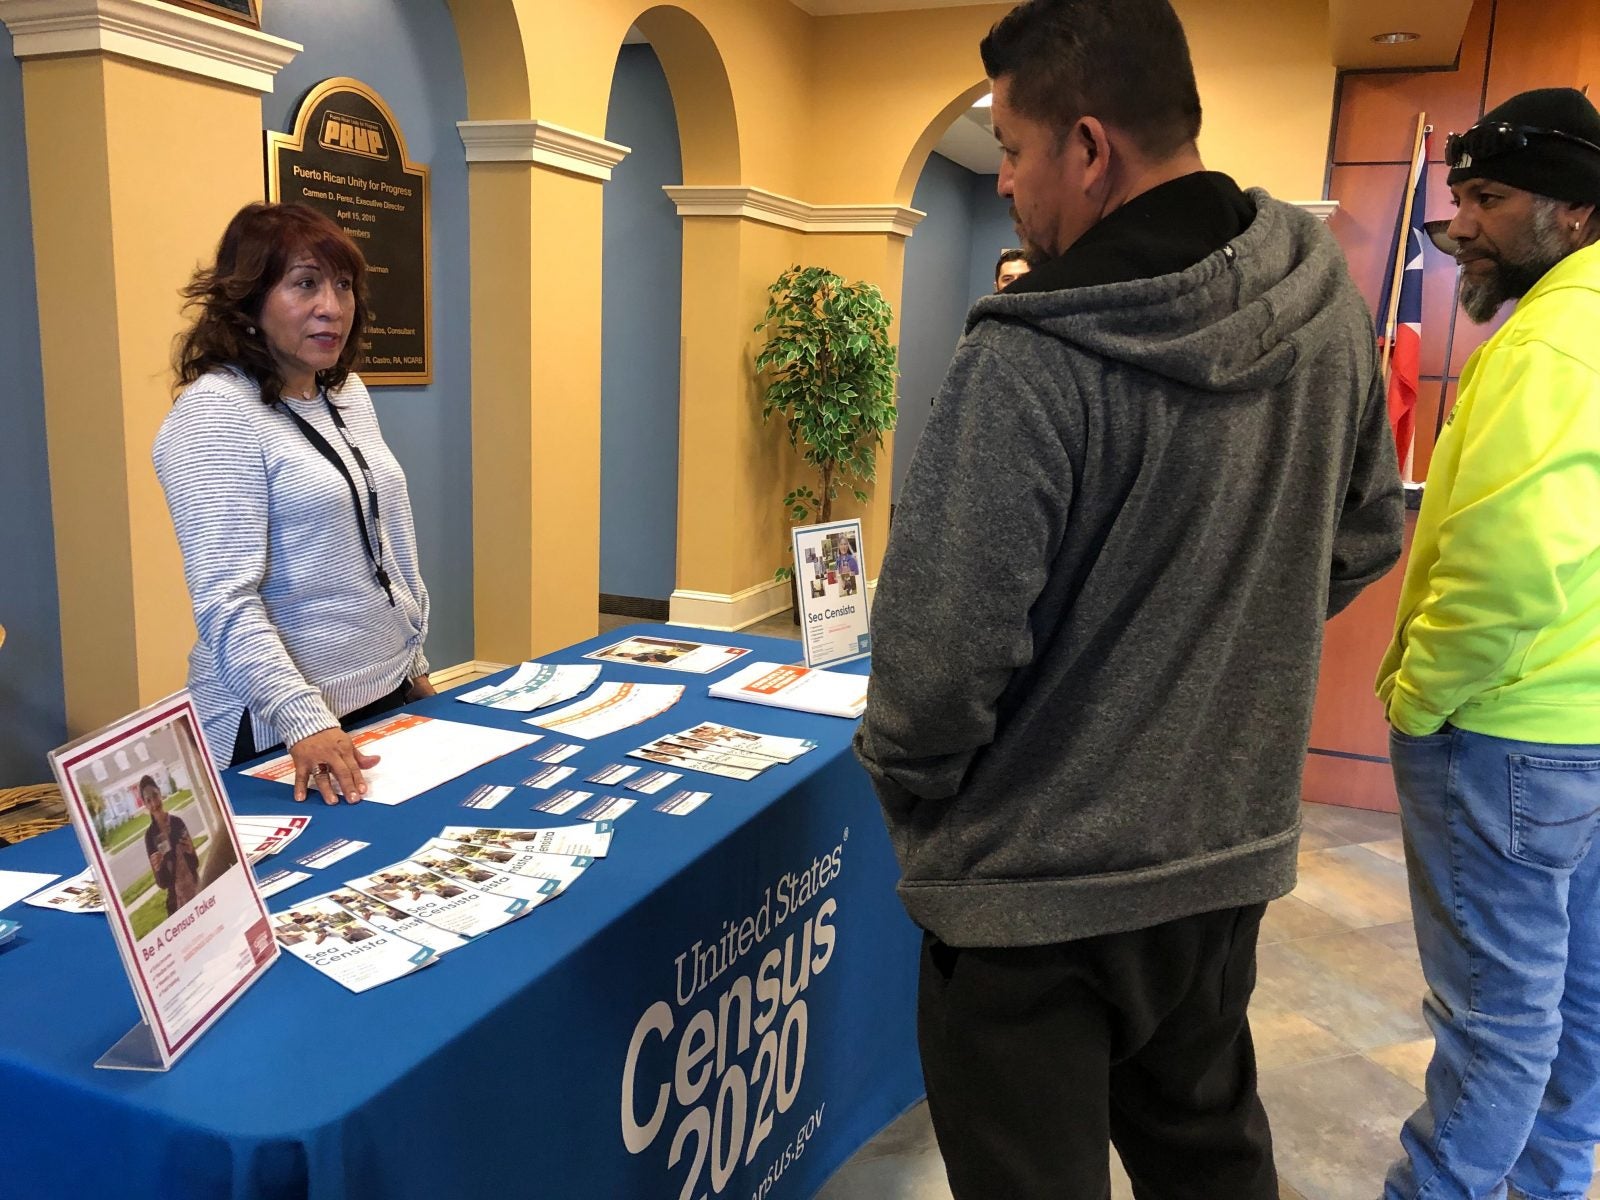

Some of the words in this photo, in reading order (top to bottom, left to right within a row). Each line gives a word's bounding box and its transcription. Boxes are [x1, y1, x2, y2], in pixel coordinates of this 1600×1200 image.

[324, 120, 384, 154] PRUP
[293, 165, 321, 180] Puerto
[323, 171, 346, 185] Rican
[347, 175, 368, 191] Unity
[369, 180, 380, 191] for
[381, 182, 412, 197] Progress
[302, 187, 327, 199] Carmen
[328, 193, 336, 201] D.
[355, 197, 383, 209] Executive
[383, 201, 405, 212] Director
[337, 210, 351, 221] April
[352, 212, 361, 221] 15,
[361, 213, 376, 223] 2010
[343, 226, 371, 239] Members
[366, 264, 389, 274] hairman
[387, 326, 416, 336] Consultant
[372, 356, 392, 365] Castro,
[808, 612, 824, 624] Sea
[824, 604, 856, 620] Censista
[539, 831, 556, 852] ensista
[508, 855, 534, 875] nsista
[480, 875, 510, 892] sista
[407, 902, 438, 914] Sea
[419, 893, 480, 918] Censista
[142, 944, 156, 962] Be
[157, 936, 165, 951] A
[164, 913, 196, 943] Census
[194, 894, 218, 919] Taker
[674, 887, 772, 1007] United
[774, 843, 843, 927] States
[304, 946, 339, 961] Sea
[315, 937, 388, 966] Censista
[620, 897, 838, 1155] Census
[667, 999, 808, 1200] 2020
